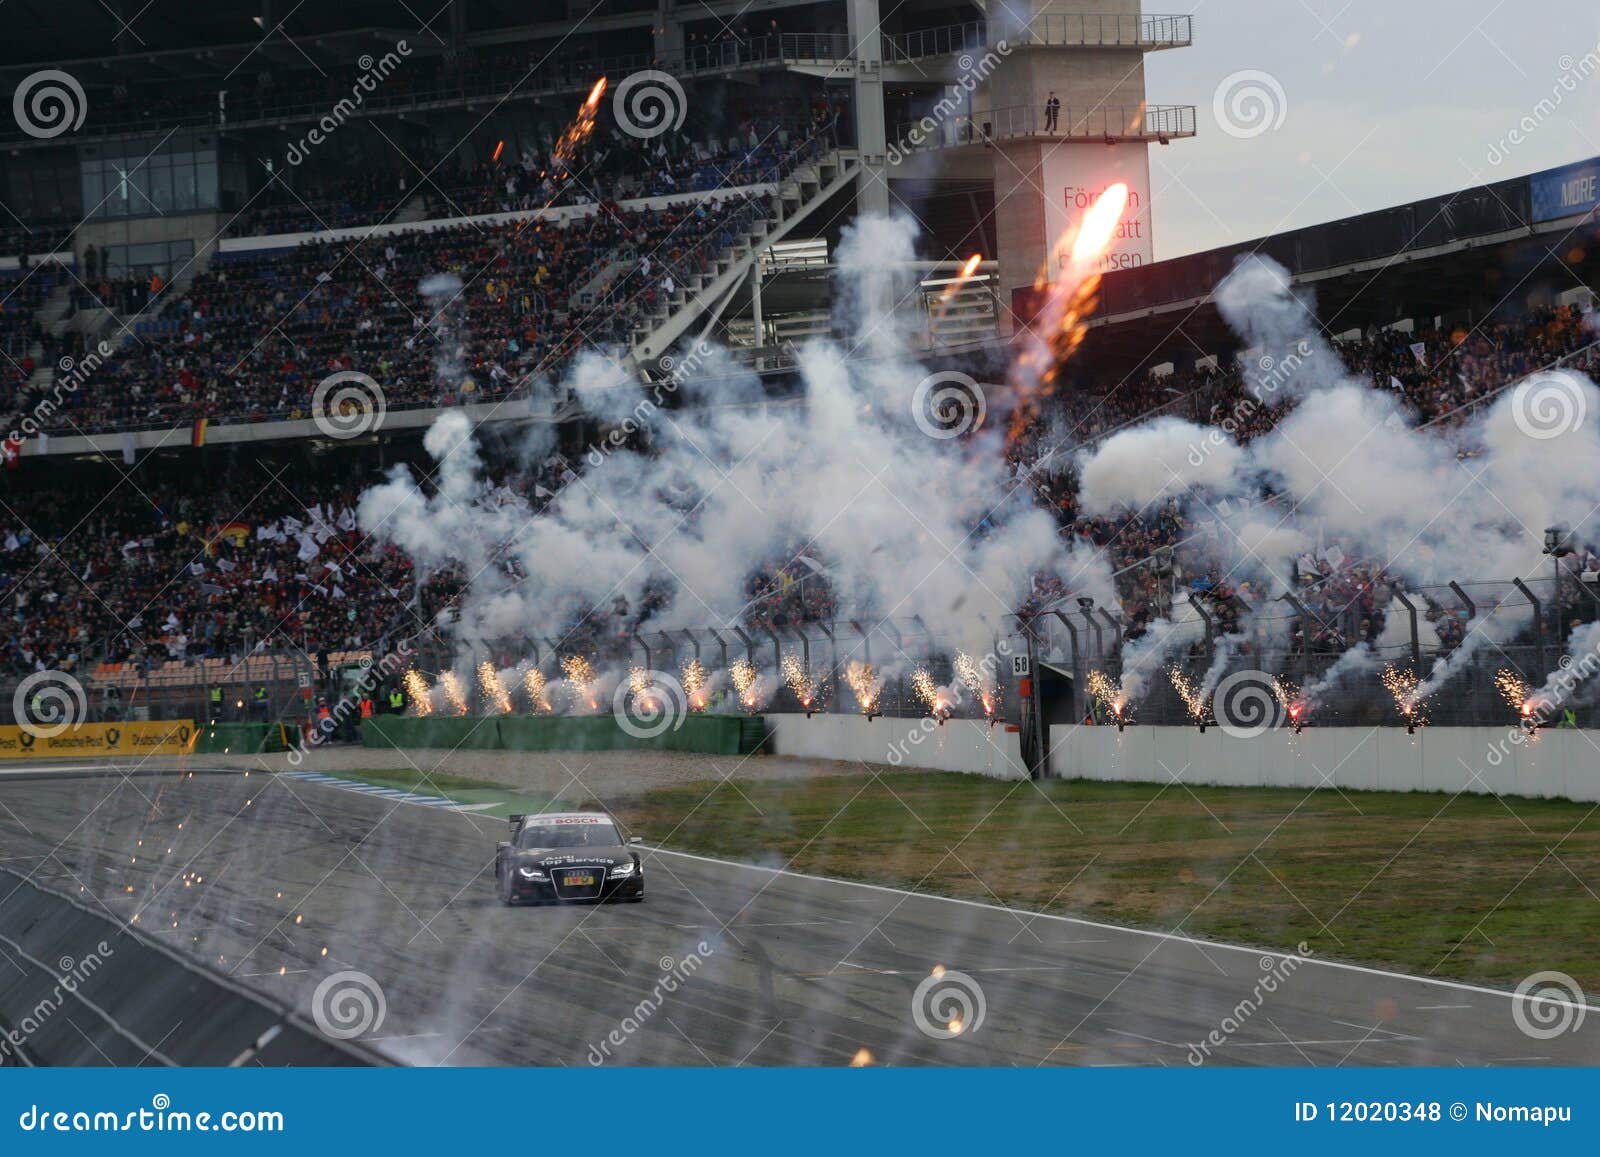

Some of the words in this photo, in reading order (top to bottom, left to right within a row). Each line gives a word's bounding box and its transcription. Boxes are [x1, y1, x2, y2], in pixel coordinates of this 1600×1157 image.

[1063, 186, 1139, 208] Förn
[1560, 175, 1597, 207] MORE
[1058, 250, 1142, 270] bsen
[1014, 656, 1028, 673] 58
[566, 857, 614, 865] Service
